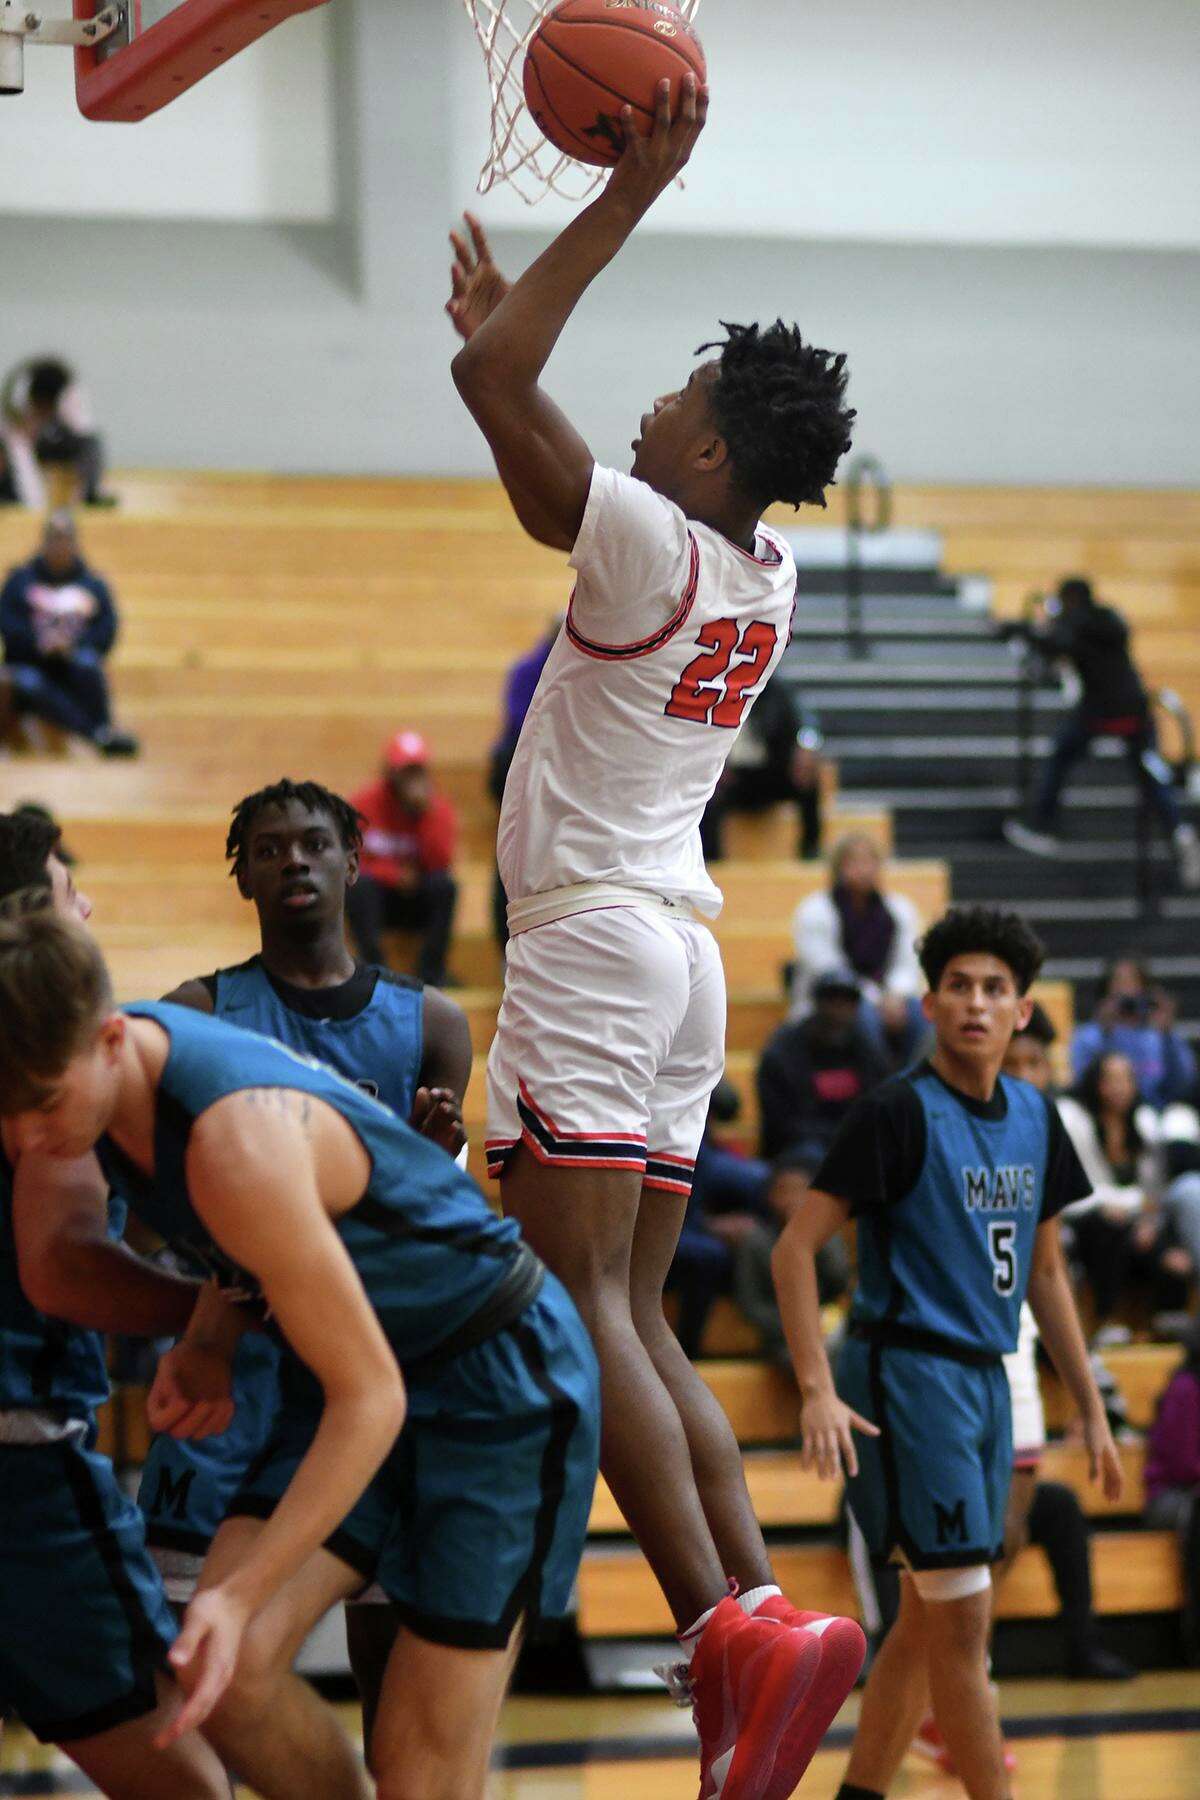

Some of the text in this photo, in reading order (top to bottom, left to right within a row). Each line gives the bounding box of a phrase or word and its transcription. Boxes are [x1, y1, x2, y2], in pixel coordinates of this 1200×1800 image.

[664, 616, 777, 728] 22
[961, 1165, 1036, 1212] MAVS
[987, 1220, 1018, 1298] 5
[151, 1464, 197, 1520] M
[932, 1498, 970, 1545] M
